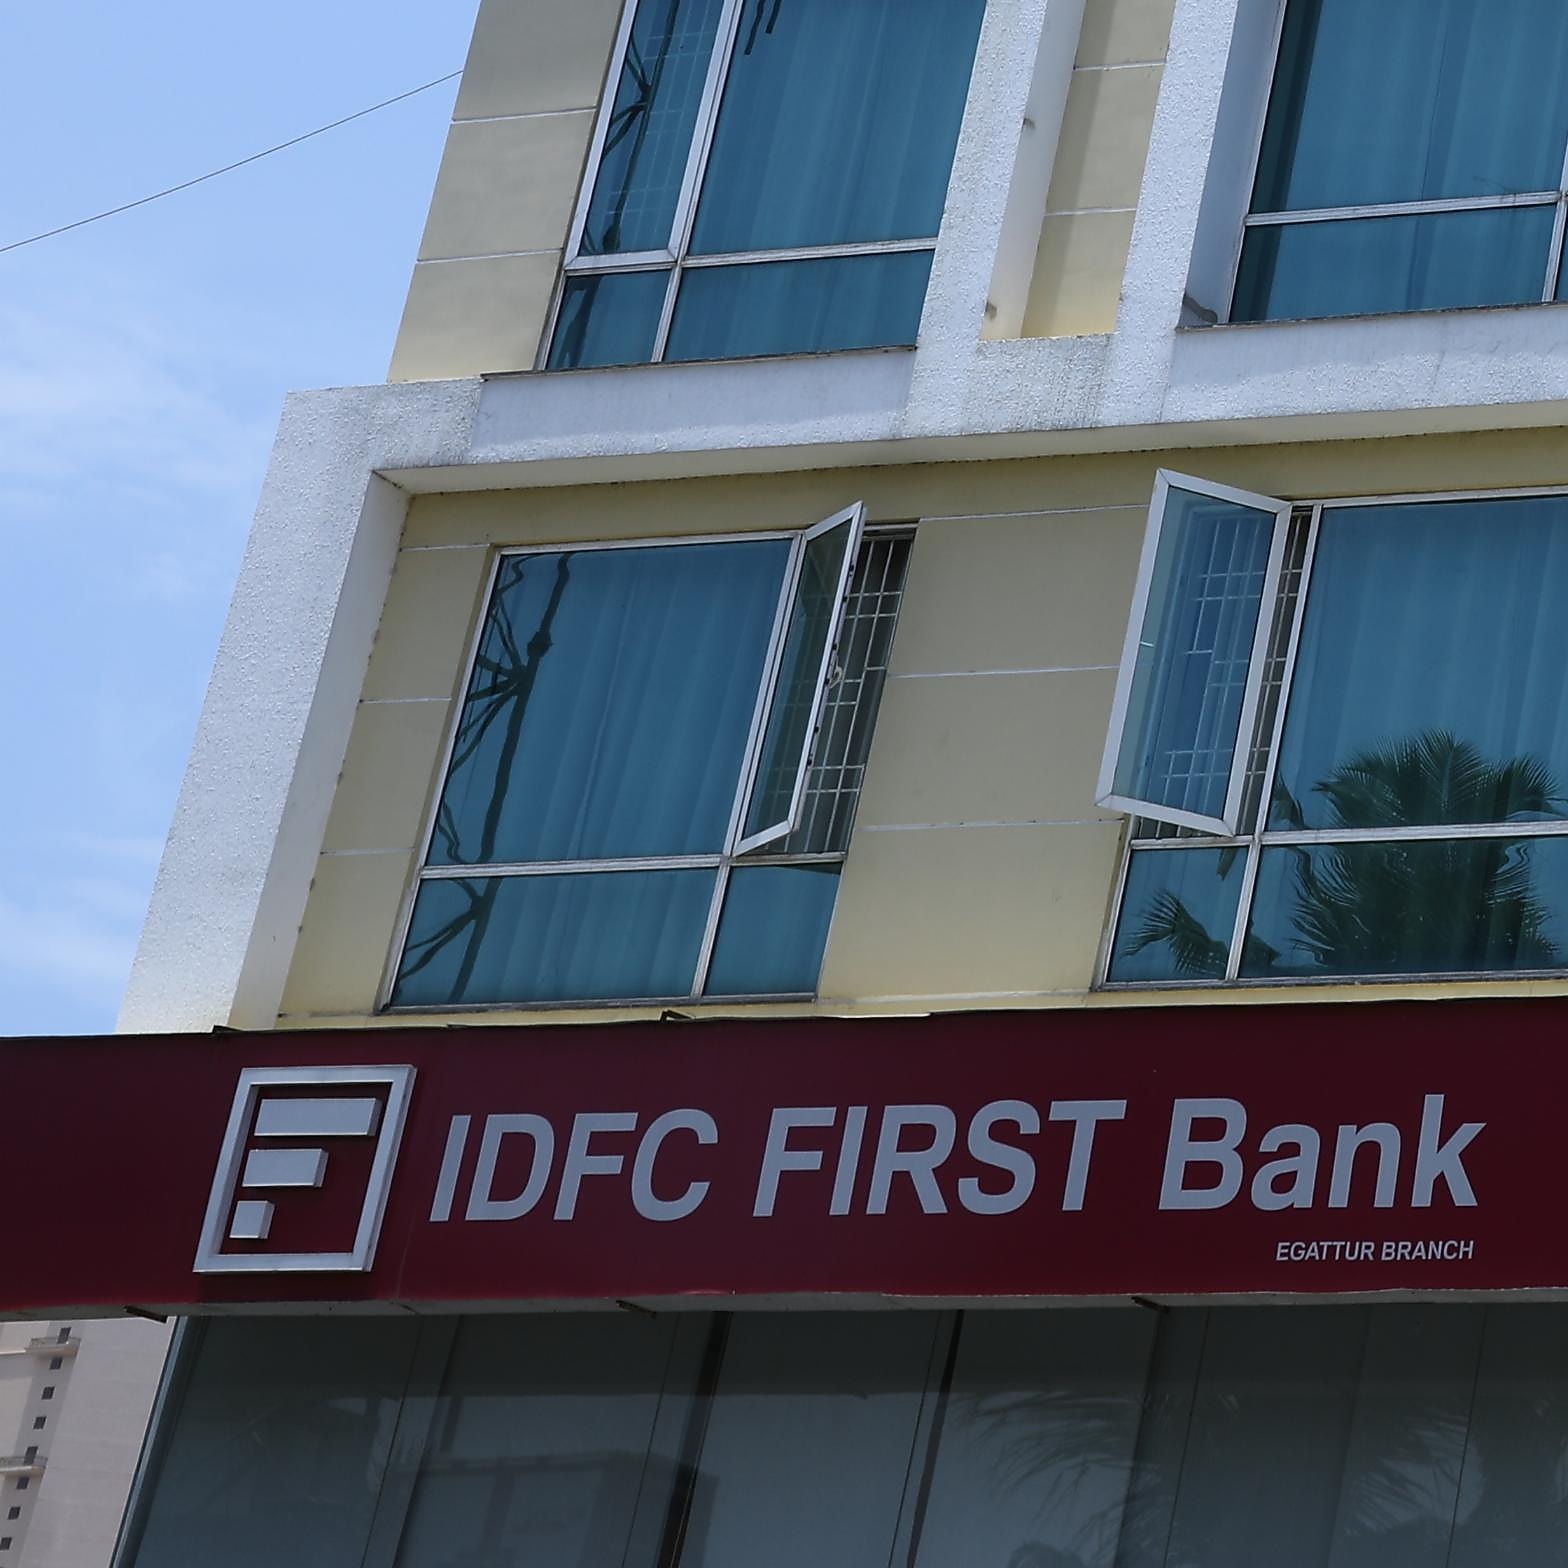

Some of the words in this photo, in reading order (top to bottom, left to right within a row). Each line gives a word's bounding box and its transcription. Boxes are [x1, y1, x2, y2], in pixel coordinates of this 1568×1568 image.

[430, 1109, 717, 1221] IDFC
[753, 1099, 1127, 1216] FIRST
[1158, 1094, 1487, 1210] Bank
[1276, 1241, 1375, 1261] EGATTUR
[1381, 1240, 1474, 1260] BRANCH
